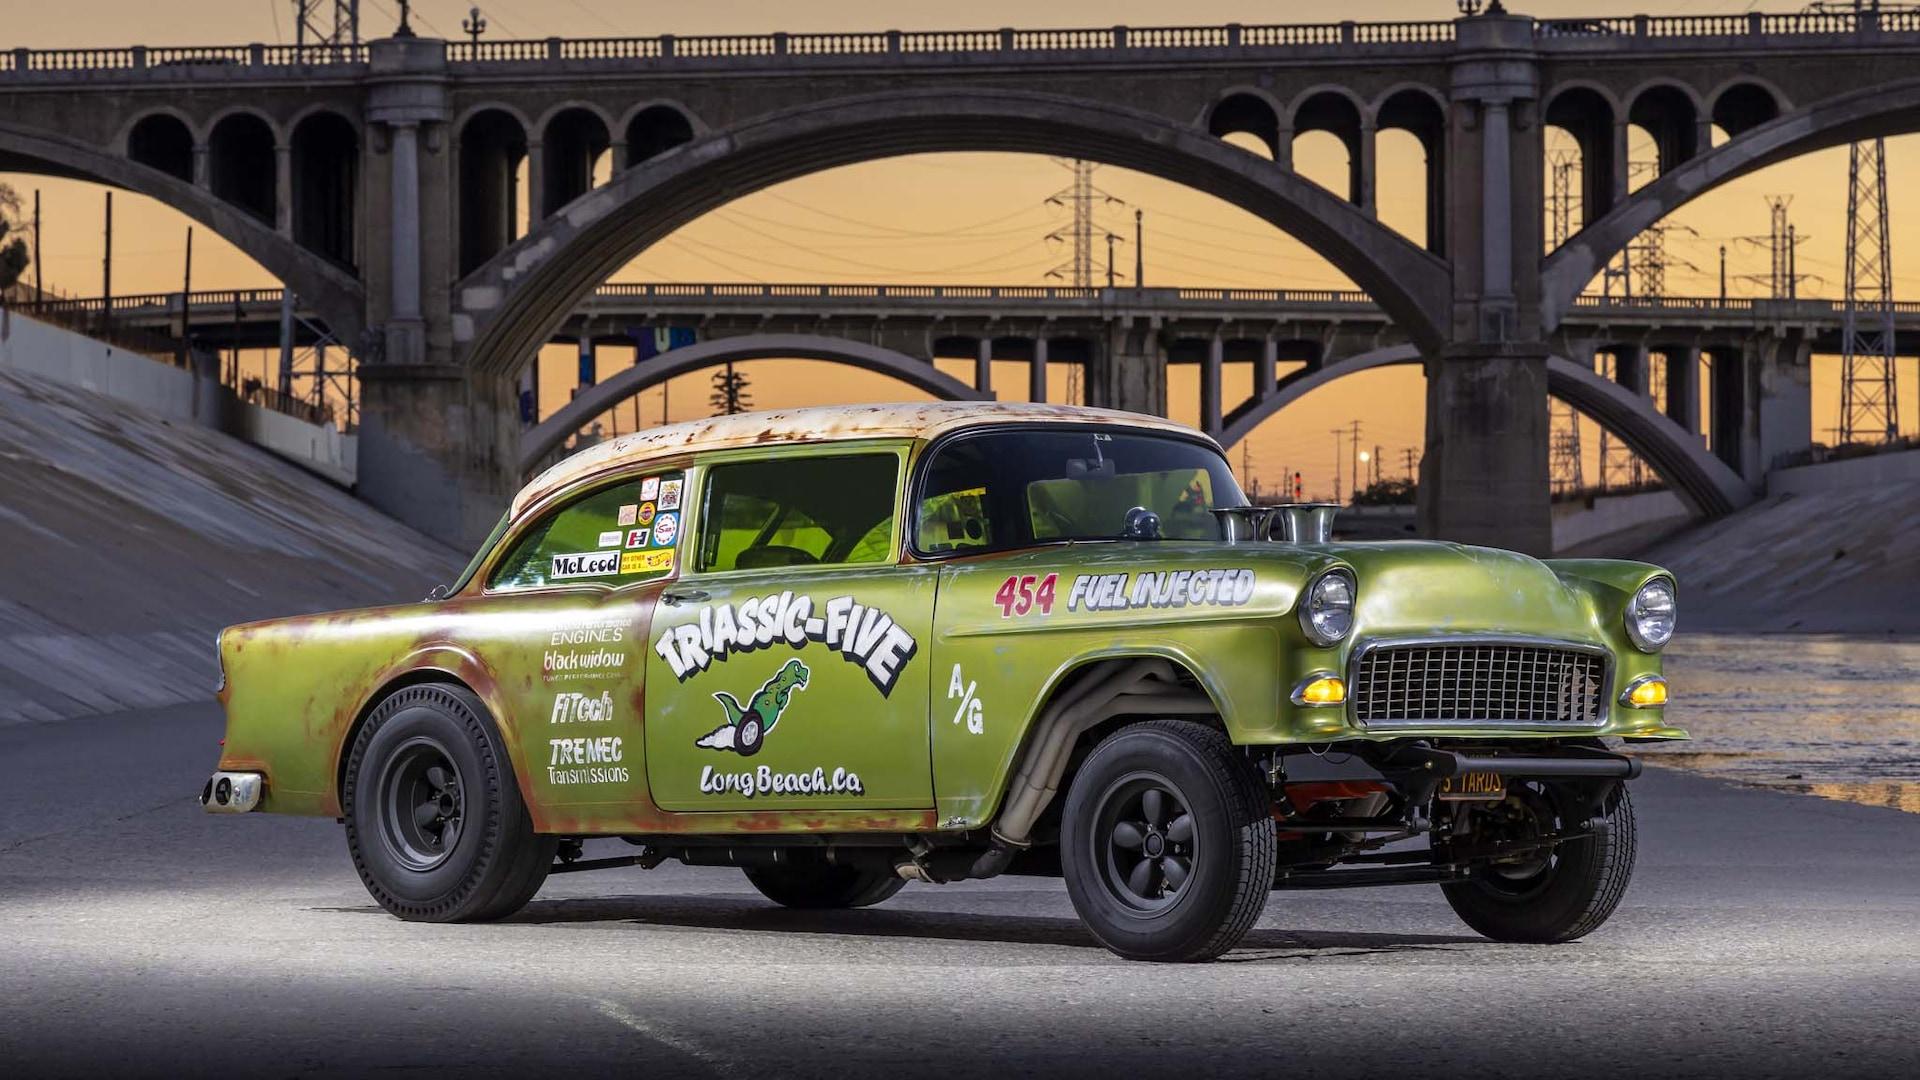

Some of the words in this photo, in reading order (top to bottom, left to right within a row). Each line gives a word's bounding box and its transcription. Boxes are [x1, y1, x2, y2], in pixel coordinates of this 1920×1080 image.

[553, 554, 618, 576] McLeod
[993, 572, 1059, 619] 454
[1067, 573, 1130, 612] FUEL
[1130, 569, 1256, 609] INJECTED
[551, 628, 623, 646] ENGINES
[655, 591, 917, 698] TRIASSIC-FIVE
[549, 737, 622, 765] TREMEC
[547, 766, 629, 784] Transmissions
[700, 765, 755, 798] Long
